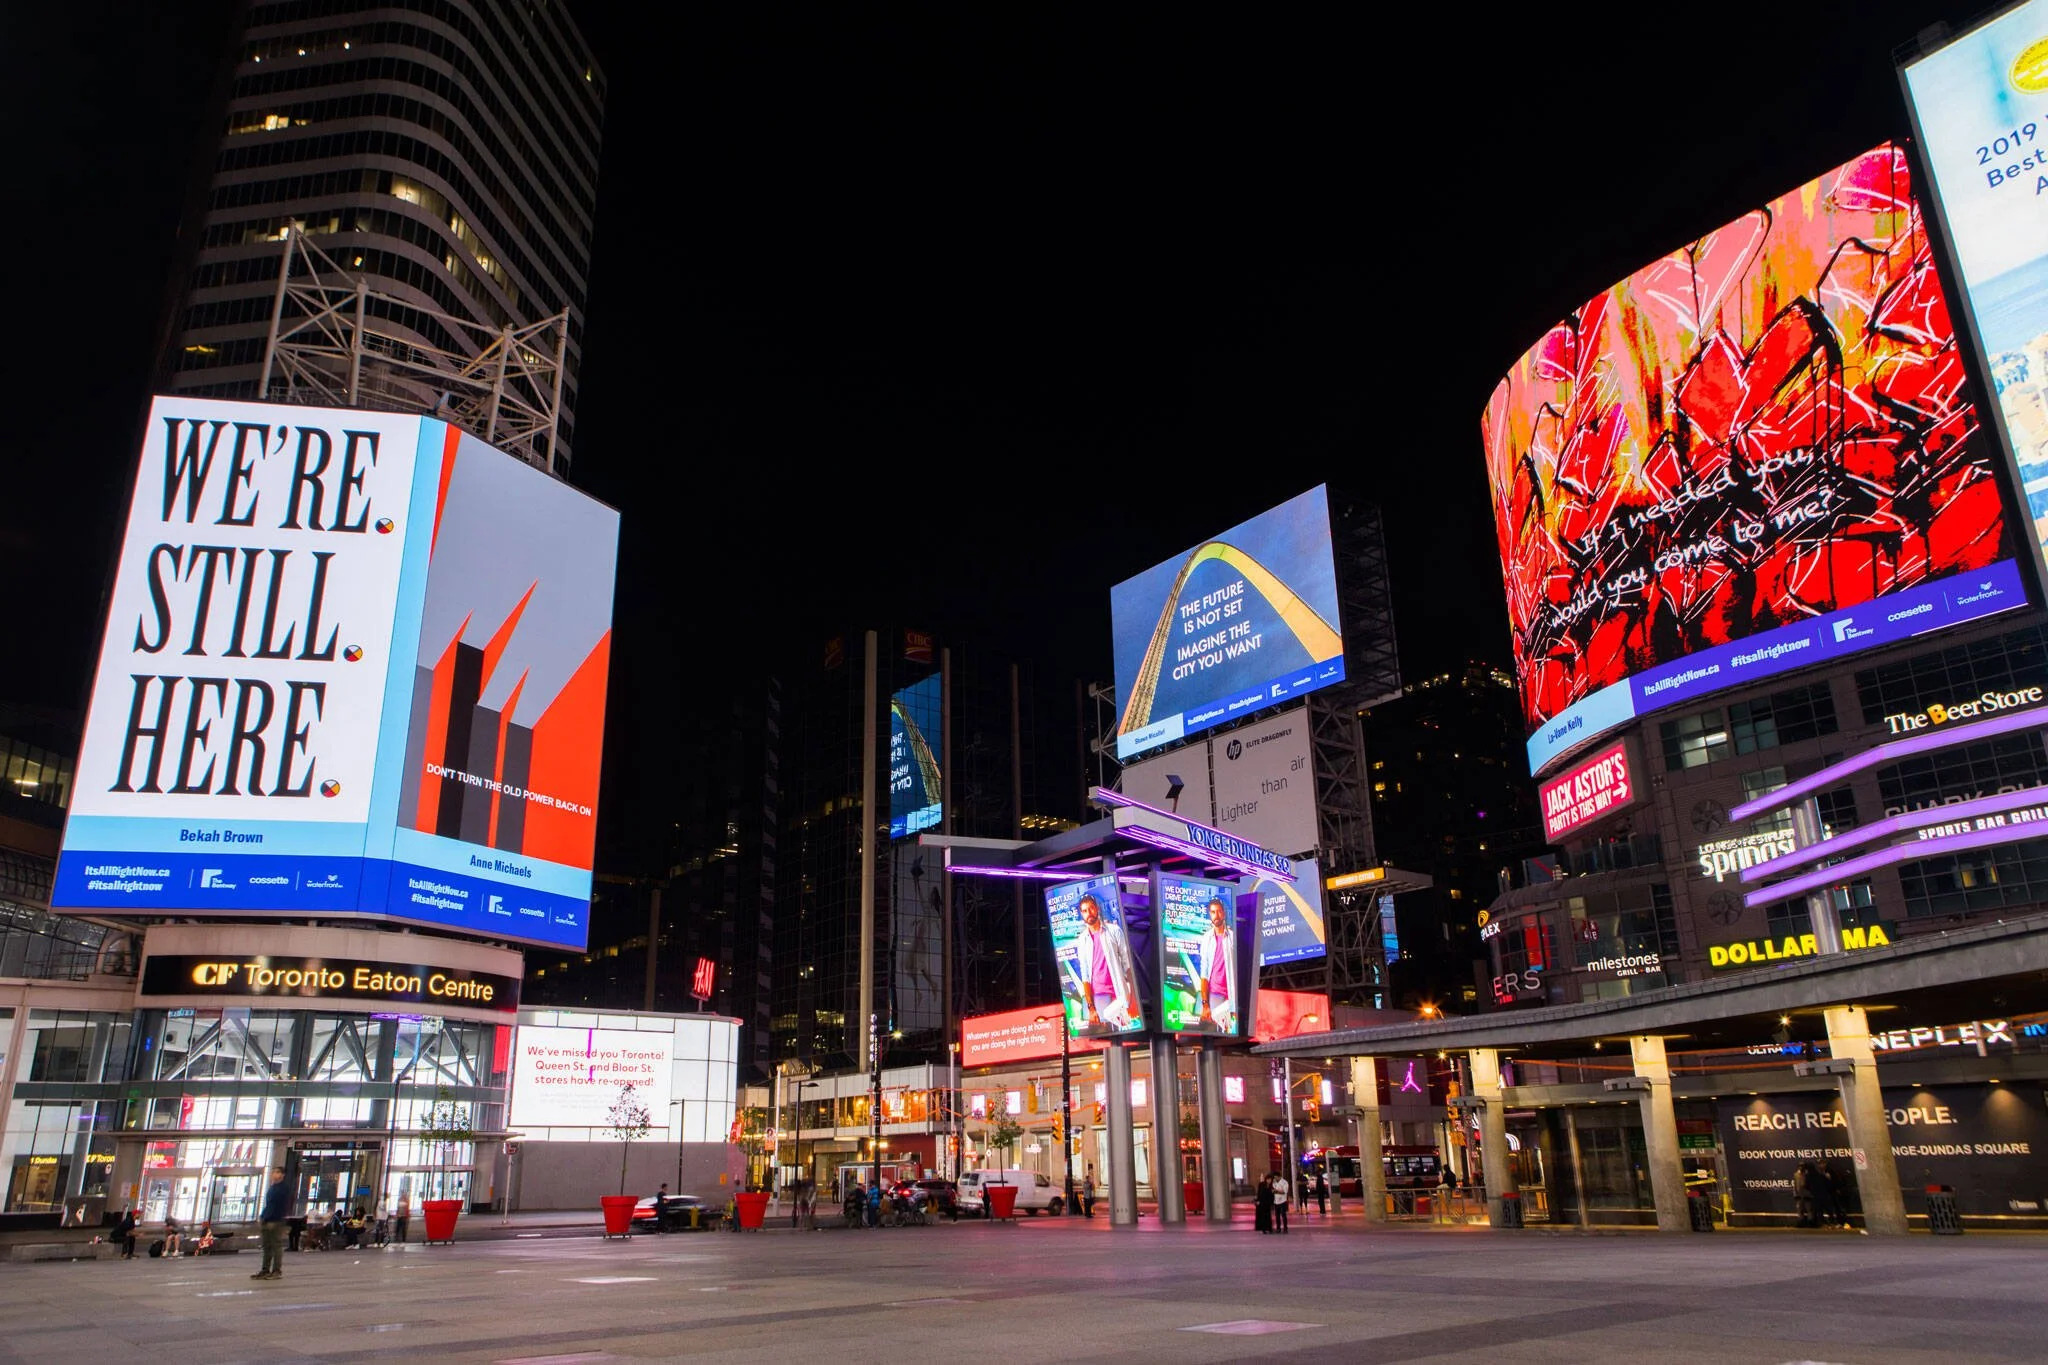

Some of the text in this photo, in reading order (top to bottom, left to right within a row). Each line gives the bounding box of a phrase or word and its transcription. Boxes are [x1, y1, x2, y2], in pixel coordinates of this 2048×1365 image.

[1976, 123, 2036, 165] 2019
[1987, 148, 2046, 188] Best
[163, 416, 394, 534] WE'RE.
[1609, 518, 1626, 539] I
[1629, 467, 1738, 526] needed
[1607, 567, 1647, 597] you
[1654, 535, 1727, 573] come
[1734, 515, 1764, 544] to
[1775, 487, 1832, 530] me?
[1180, 580, 1244, 619] THE FUTURE
[1957, 589, 1997, 606] waterfront
[1183, 599, 1243, 635] IS NOT SET
[1887, 602, 1933, 622] cossette
[1177, 620, 1251, 662] IMAGINE THE
[1172, 634, 1263, 681] CITY YOU WANT
[1644, 637, 1810, 696] ItsAllRightNow.ca #itsallrightnow
[1567, 715, 1582, 732] Kelly
[1884, 712, 1928, 734] The
[1246, 728, 1292, 748] ELITE DRAGONFLY
[1227, 740, 1242, 760] hp
[1290, 755, 1305, 771] air
[426, 763, 592, 816] DON'T TURN THE OLD POWER BACK ON
[1261, 777, 1288, 794] than
[1546, 753, 1625, 817] JACK ASTOR'S
[1221, 801, 1258, 822] Lighter
[1549, 788, 1612, 834] PARTY IS THIS WAY
[179, 829, 263, 844] Bekah Brown
[1918, 821, 1971, 840] SPORTS
[1976, 815, 2006, 830] BAR
[84, 865, 170, 878] ItsAllRightNow.ca
[469, 854, 532, 878] Anne Michaels
[87, 879, 163, 893] #itsallrightnow
[249, 876, 288, 885] cossette
[1264, 895, 1286, 906] FUTURE
[1275, 904, 1285, 912] SET
[1262, 916, 1289, 928] GINE THE
[1262, 924, 1295, 937] YOU WANT
[1710, 925, 1889, 967] DOLLARMA
[1587, 953, 1659, 972] milestones
[1617, 965, 1661, 977] GRILL BAR
[192, 963, 493, 1002] CF Toronto Eaton Centre
[966, 1031, 990, 1040] Whatever
[1011, 1025, 1026, 1034] doing
[1870, 1021, 2012, 1050] NEPLEX
[527, 1046, 664, 1060] We've missed you Toronto!
[971, 1044, 980, 1053] you
[991, 1040, 1006, 1049] doing
[1007, 1038, 1015, 1046] the
[1017, 1036, 1029, 1046] right
[535, 1061, 654, 1073] Queen St. and Bloor St.
[535, 1075, 653, 1087] stores have re-opened!
[1734, 1107, 1958, 1131] REACH REA EOPLE.
[1739, 1143, 2030, 1160] BOOK YOUR NEXT EVEN NGE-DUNDAS SQUARE
